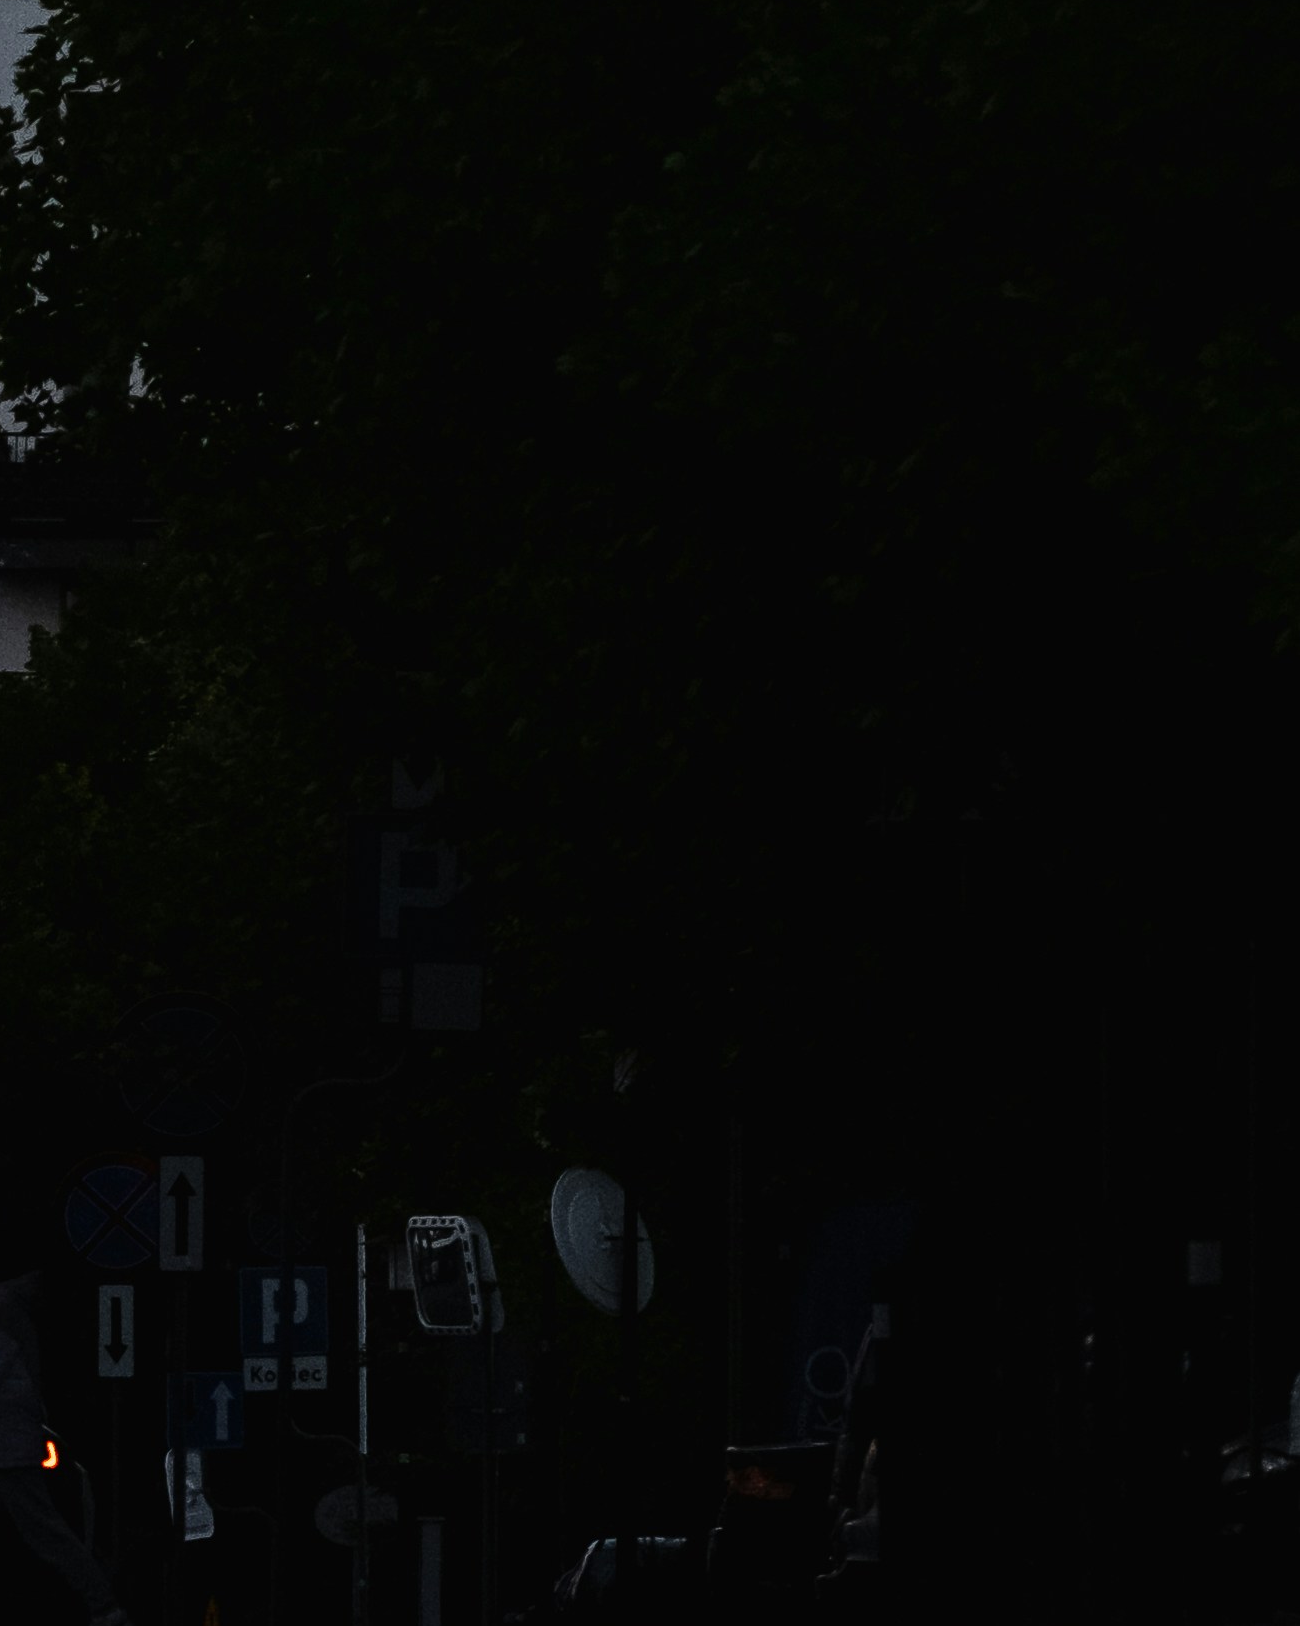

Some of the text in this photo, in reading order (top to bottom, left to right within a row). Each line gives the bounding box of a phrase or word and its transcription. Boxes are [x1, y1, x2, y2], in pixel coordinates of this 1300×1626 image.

[379, 831, 457, 939] P
[261, 1278, 309, 1344] P
[250, 1365, 322, 1383] Koiec
